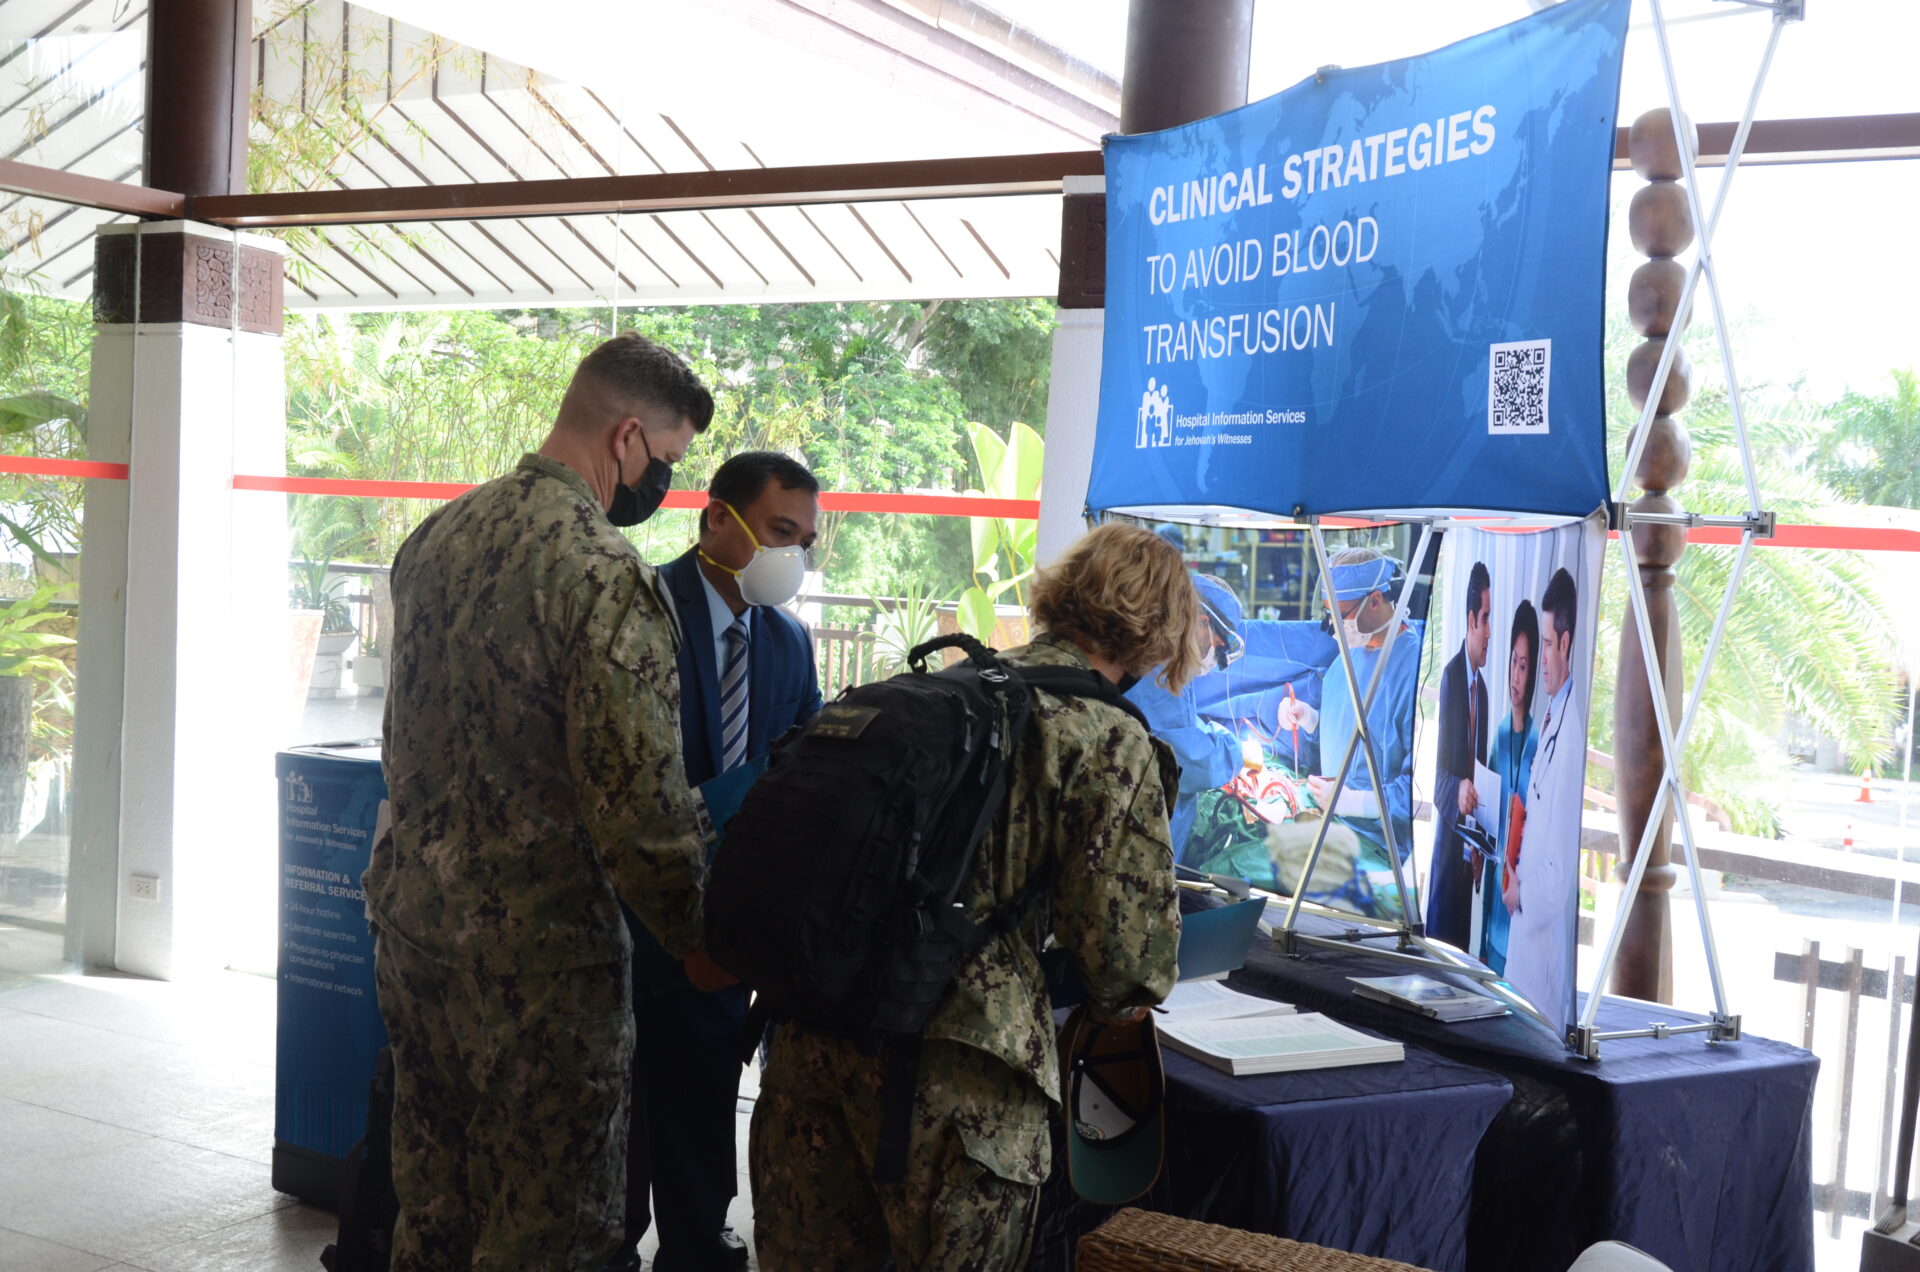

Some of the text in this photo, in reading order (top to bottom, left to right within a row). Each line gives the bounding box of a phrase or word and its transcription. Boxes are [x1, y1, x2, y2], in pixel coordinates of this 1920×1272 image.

[1149, 104, 1497, 226] CLINICAL STRATEGIES
[1146, 215, 1379, 295] TO AVOID BLOOD
[1144, 302, 1335, 365] TRANSFUSION
[1176, 409, 1306, 430] Hospital Information Services
[1175, 433, 1252, 446] for Jehovah's Witnesses
[286, 803, 318, 816] Hospital
[286, 816, 367, 838] Information Services
[284, 863, 350, 885] INFORMATION &
[284, 878, 327, 895] REFERRAL
[316, 906, 342, 920] hotline
[289, 920, 357, 943] Literature searches
[289, 955, 335, 972] consultations
[289, 972, 363, 996] International network
